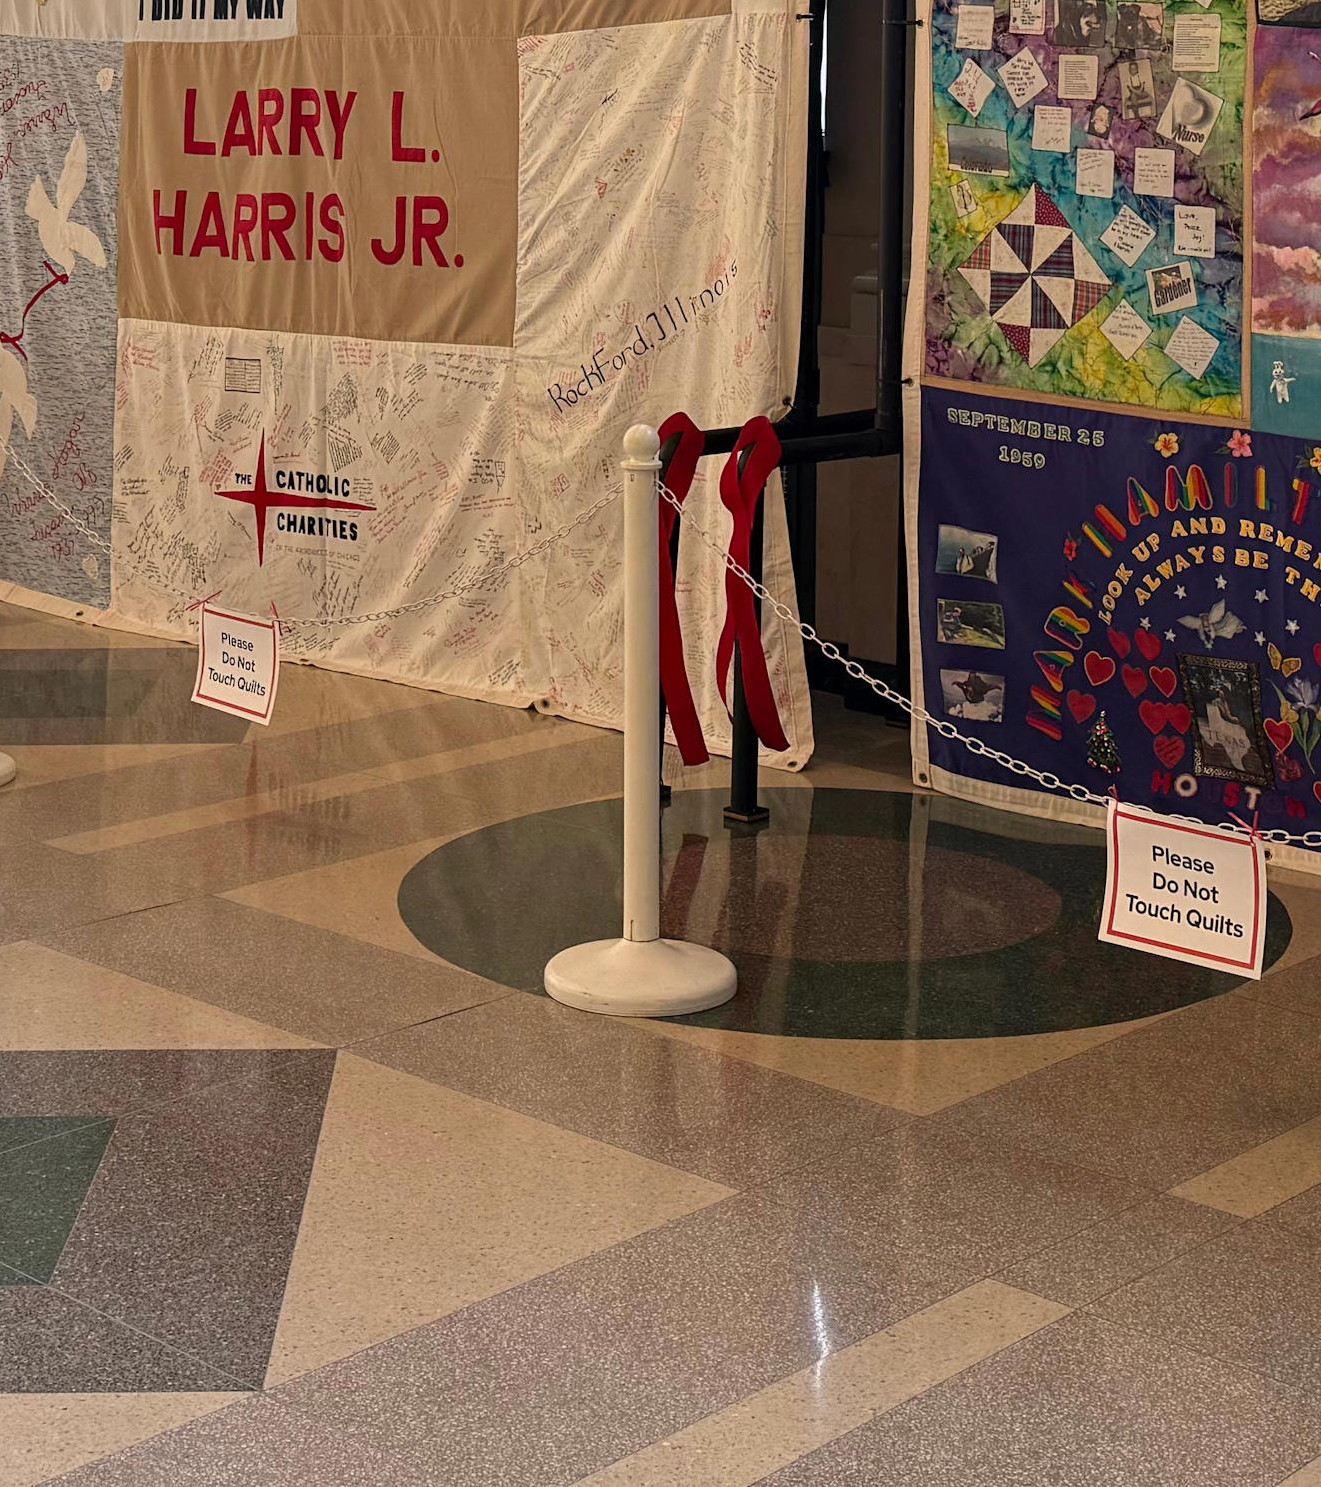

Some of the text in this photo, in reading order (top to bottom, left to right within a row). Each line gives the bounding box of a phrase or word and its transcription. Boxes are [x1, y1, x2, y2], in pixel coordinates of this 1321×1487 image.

[184, 87, 441, 164] LARRY L.
[1175, 122, 1205, 144] Nurse
[154, 189, 465, 268] HARRIS JR.
[1154, 276, 1192, 308] Gardener
[947, 407, 1105, 447] SEPTEMBER 25
[998, 445, 1046, 469] 1959
[235, 470, 351, 498] THE CATHOLIC
[277, 512, 359, 541] CHARITIES
[1098, 563, 1134, 625] LOOK
[1132, 532, 1160, 562] UP
[1171, 517, 1227, 538] AND
[1134, 545, 1225, 607] ALWAYS
[1234, 549, 1269, 570] BE
[221, 632, 254, 651] Please
[222, 651, 255, 672] Do Not
[208, 667, 266, 697] Touch Quilts
[1206, 729, 1246, 750] TEXAS
[1152, 845, 1215, 874] Please
[1153, 872, 1219, 904] Do Not
[1126, 894, 1244, 938] Touch Quilts
